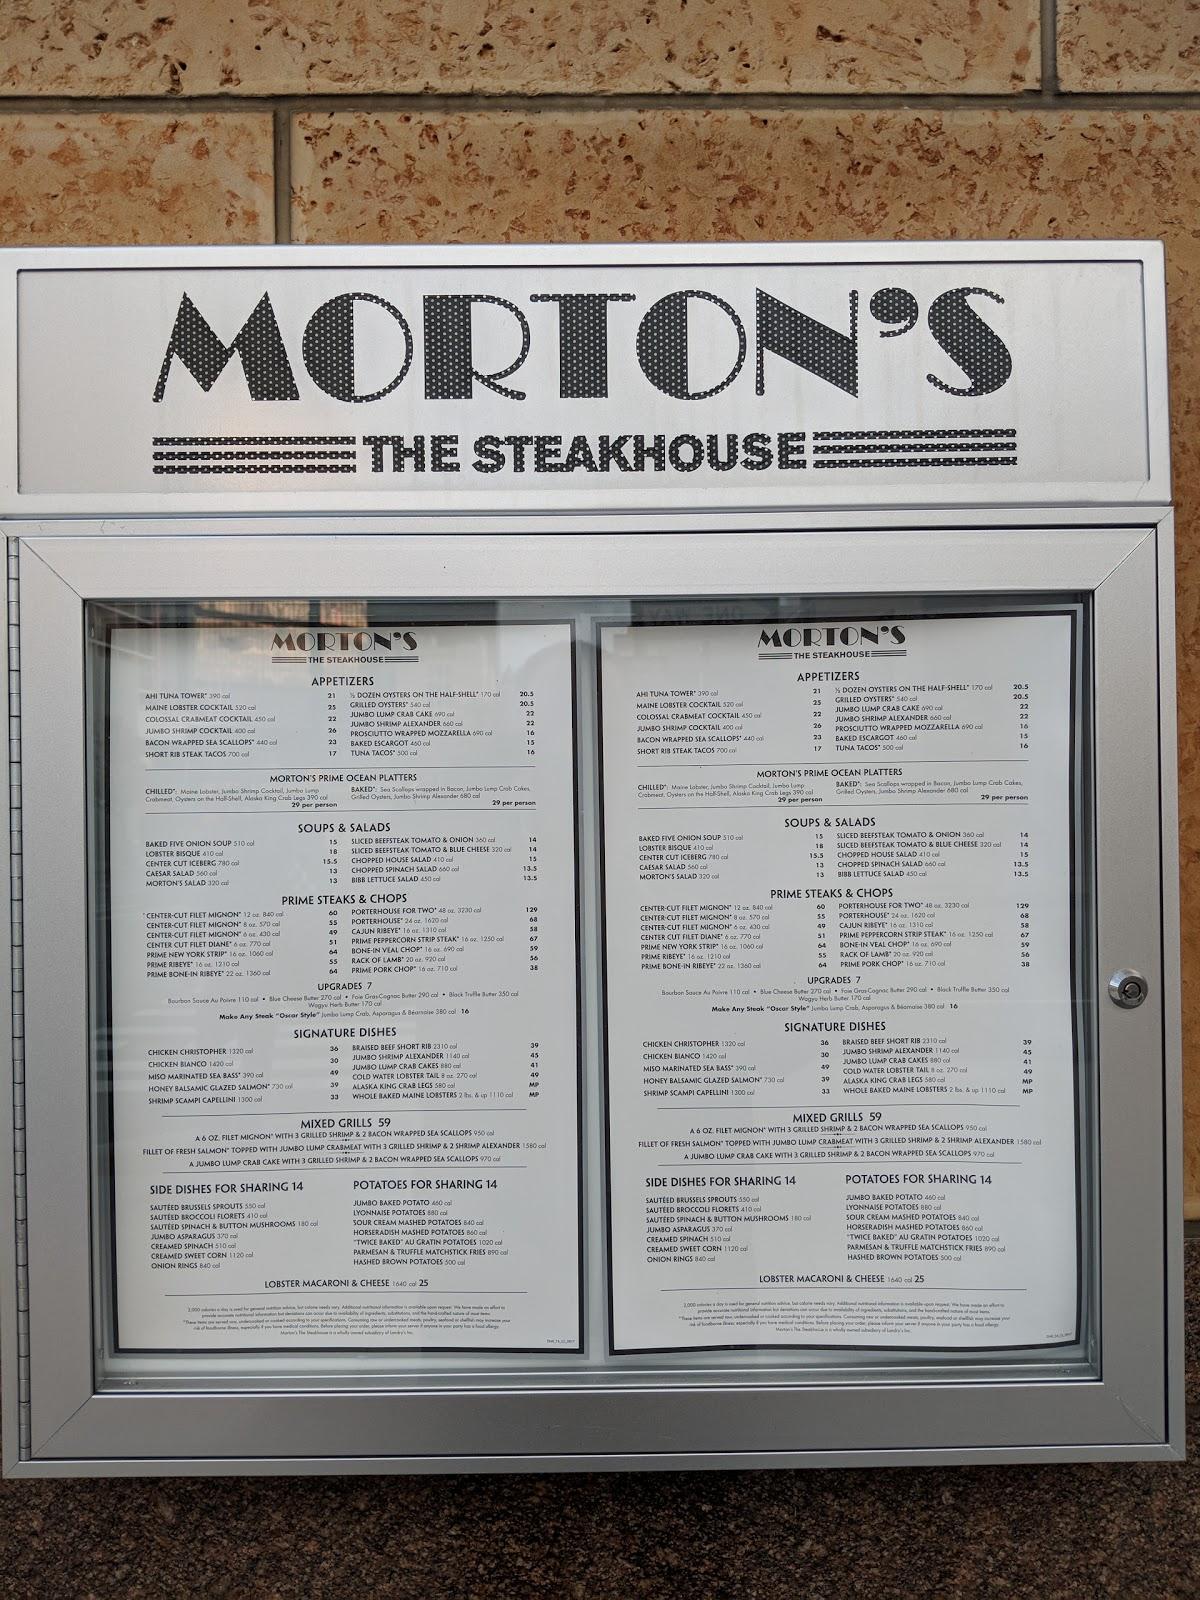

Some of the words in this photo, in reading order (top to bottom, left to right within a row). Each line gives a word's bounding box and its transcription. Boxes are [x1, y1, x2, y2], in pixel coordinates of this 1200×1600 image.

[152, 287, 1013, 403] MORTON'S
[363, 434, 460, 473] THE
[471, 432, 807, 473] STEAKHOUSE
[271, 632, 418, 651] MORTON'S
[758, 625, 906, 648] MORTON'S
[812, 650, 870, 659] STEAKHOUSE
[311, 676, 374, 686] APPETIZERS
[796, 671, 859, 682] APPETIZERS
[269, 774, 316, 783] MORTON'S
[318, 774, 343, 782] PRIME
[345, 774, 376, 782] OCEAN
[378, 773, 417, 782] PLATTERS
[756, 769, 802, 778] MORTON'S
[803, 769, 828, 777] PRIME
[830, 768, 861, 777] OCEAN
[863, 768, 902, 776] PLATTERS
[298, 823, 334, 833] SOUPS
[338, 823, 346, 833] &
[350, 822, 390, 832] SALADS
[784, 817, 820, 828] SOUPS
[823, 817, 831, 827] &
[835, 816, 875, 827] SALADS
[281, 895, 314, 905] PRIME
[317, 894, 355, 904] STEAKS
[358, 894, 366, 904] &
[369, 893, 407, 904] CHOPS
[770, 889, 802, 899] PRIME
[805, 888, 842, 899] STEAKS
[845, 888, 853, 898] &
[856, 888, 893, 898] CHOPS
[807, 976, 851, 984] UPGRADES
[317, 982, 362, 991] UPGRADES
[367, 981, 372, 990] 7
[784, 1022, 845, 1032] SIGNATURE
[849, 1021, 886, 1031] DISHES
[293, 1028, 355, 1039] SIGNATURE
[359, 1027, 396, 1037] DISHES
[792, 1113, 827, 1123] MIXED
[829, 1112, 863, 1122] GRILLS
[869, 1111, 882, 1122] 59
[300, 1118, 335, 1129] MIXED
[338, 1117, 372, 1128] GRILLS
[378, 1117, 391, 1127] 59
[353, 1179, 407, 1190] POTATOES
[410, 1179, 432, 1189] FOR
[435, 1179, 483, 1189] SHARING
[486, 1179, 497, 1189] 14
[645, 1177, 667, 1187] SIDE
[670, 1177, 706, 1187] DISHES
[709, 1176, 731, 1186] FOR
[734, 1175, 781, 1186] SHARING
[784, 1176, 796, 1185] 14
[845, 1174, 900, 1184] POTATOES
[903, 1174, 924, 1184] FOR
[927, 1174, 976, 1184] SHARING
[980, 1175, 992, 1184] 14
[150, 1184, 172, 1195] SIDE
[175, 1184, 211, 1194] DISHES
[214, 1183, 237, 1194] FOR
[240, 1182, 288, 1193] SHARING
[292, 1181, 303, 1191] 14
[264, 1279, 300, 1288] LOBSTER
[302, 1279, 349, 1287] MACARONI
[359, 1279, 389, 1287] CHEESE
[418, 1278, 428, 1287] 25
[759, 1274, 794, 1283] LOBSTER
[796, 1274, 844, 1282] MACARONI
[846, 1274, 852, 1282] &
[854, 1274, 884, 1282] CHEESE
[914, 1274, 924, 1283] 25
